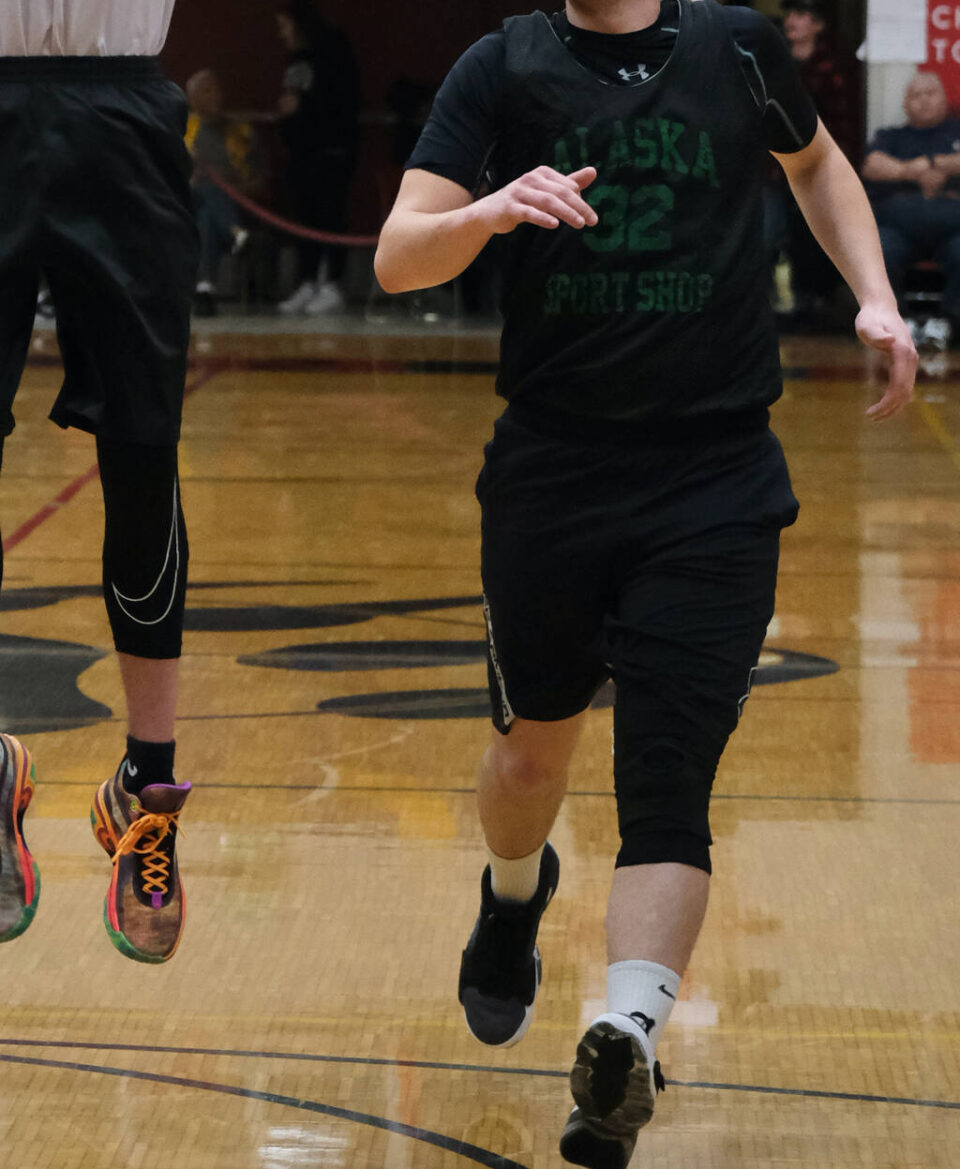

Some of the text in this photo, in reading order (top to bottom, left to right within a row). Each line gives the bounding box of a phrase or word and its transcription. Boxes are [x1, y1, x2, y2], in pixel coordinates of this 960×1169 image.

[581, 184, 675, 252] 32
[543, 272, 713, 315] SPORT SHOP
